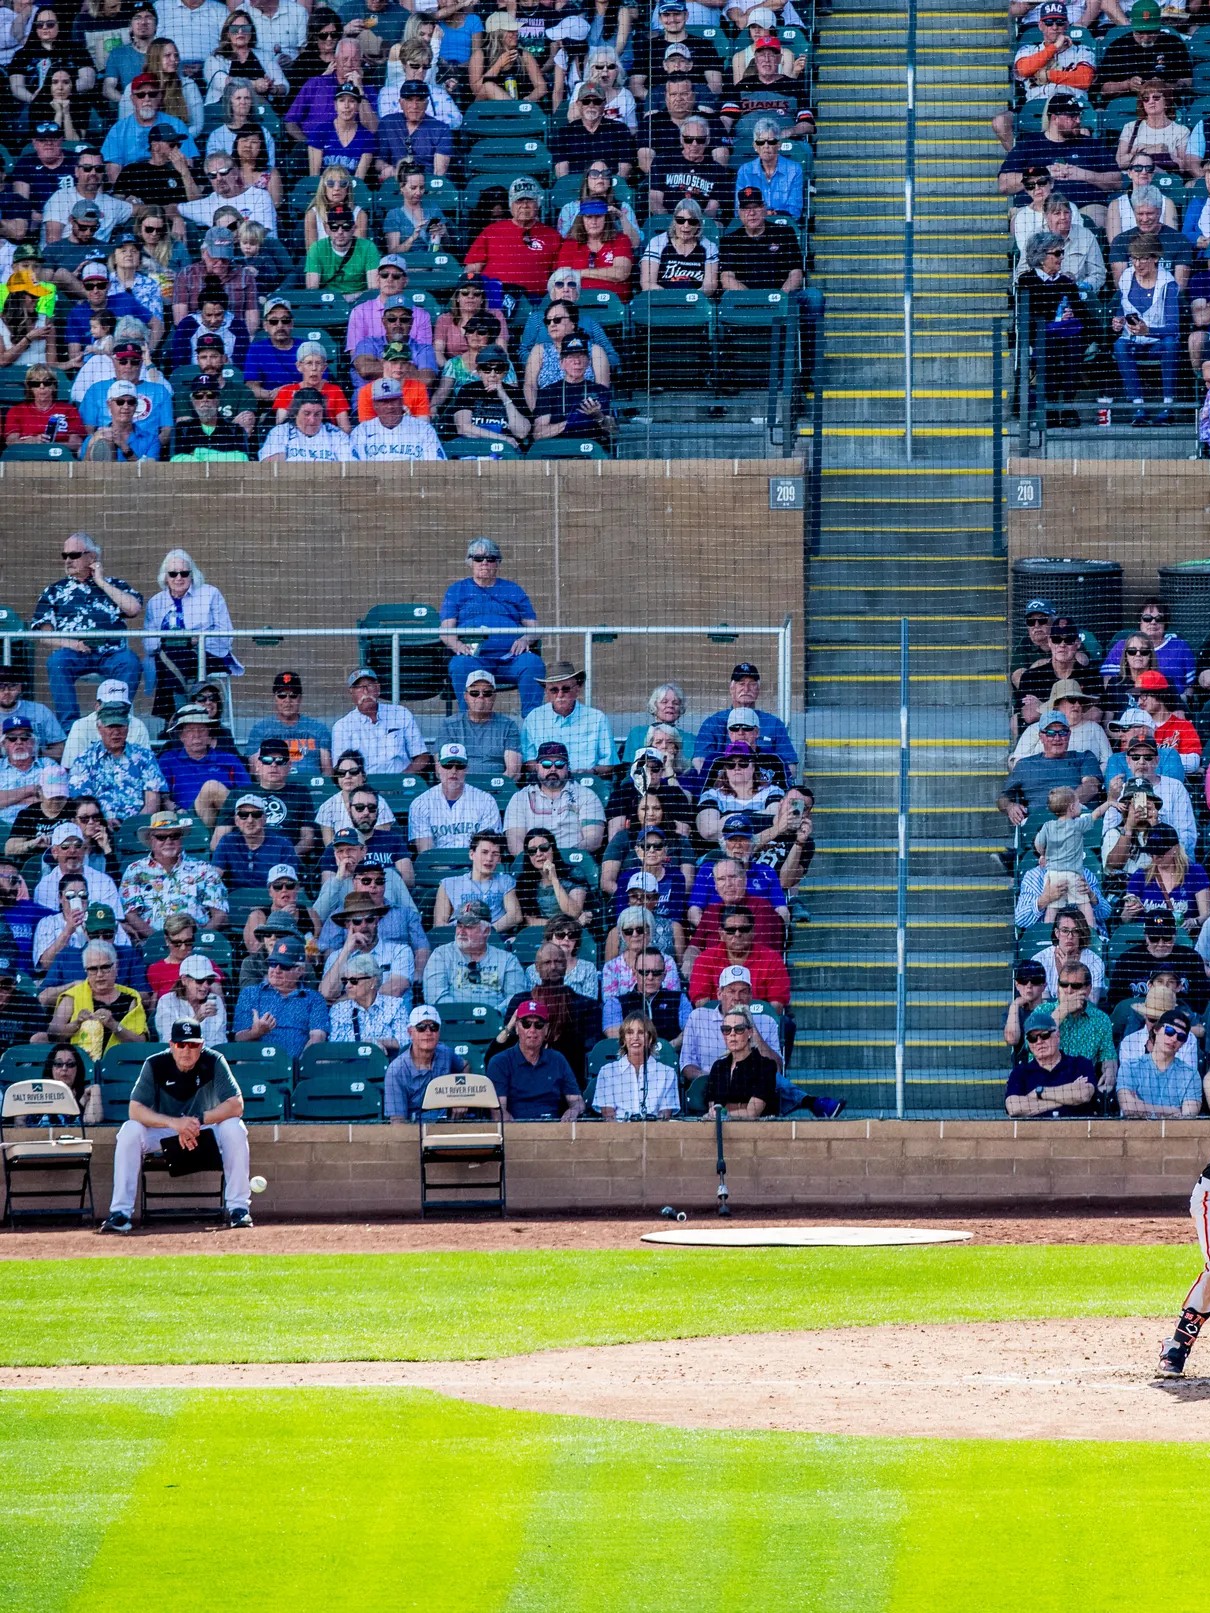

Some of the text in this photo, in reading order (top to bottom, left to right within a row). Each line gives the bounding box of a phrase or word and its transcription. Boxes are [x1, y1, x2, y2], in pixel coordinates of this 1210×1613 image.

[1045, 4, 1063, 13] SAC
[666, 173, 691, 188] WORLD
[662, 265, 705, 281] Giants
[776, 486, 795, 502] 209
[1018, 486, 1034, 501] 210
[13, 1094, 26, 1102] SALT
[46, 1092, 65, 1100] FIELDS
[468, 1085, 487, 1094] FIELDS
